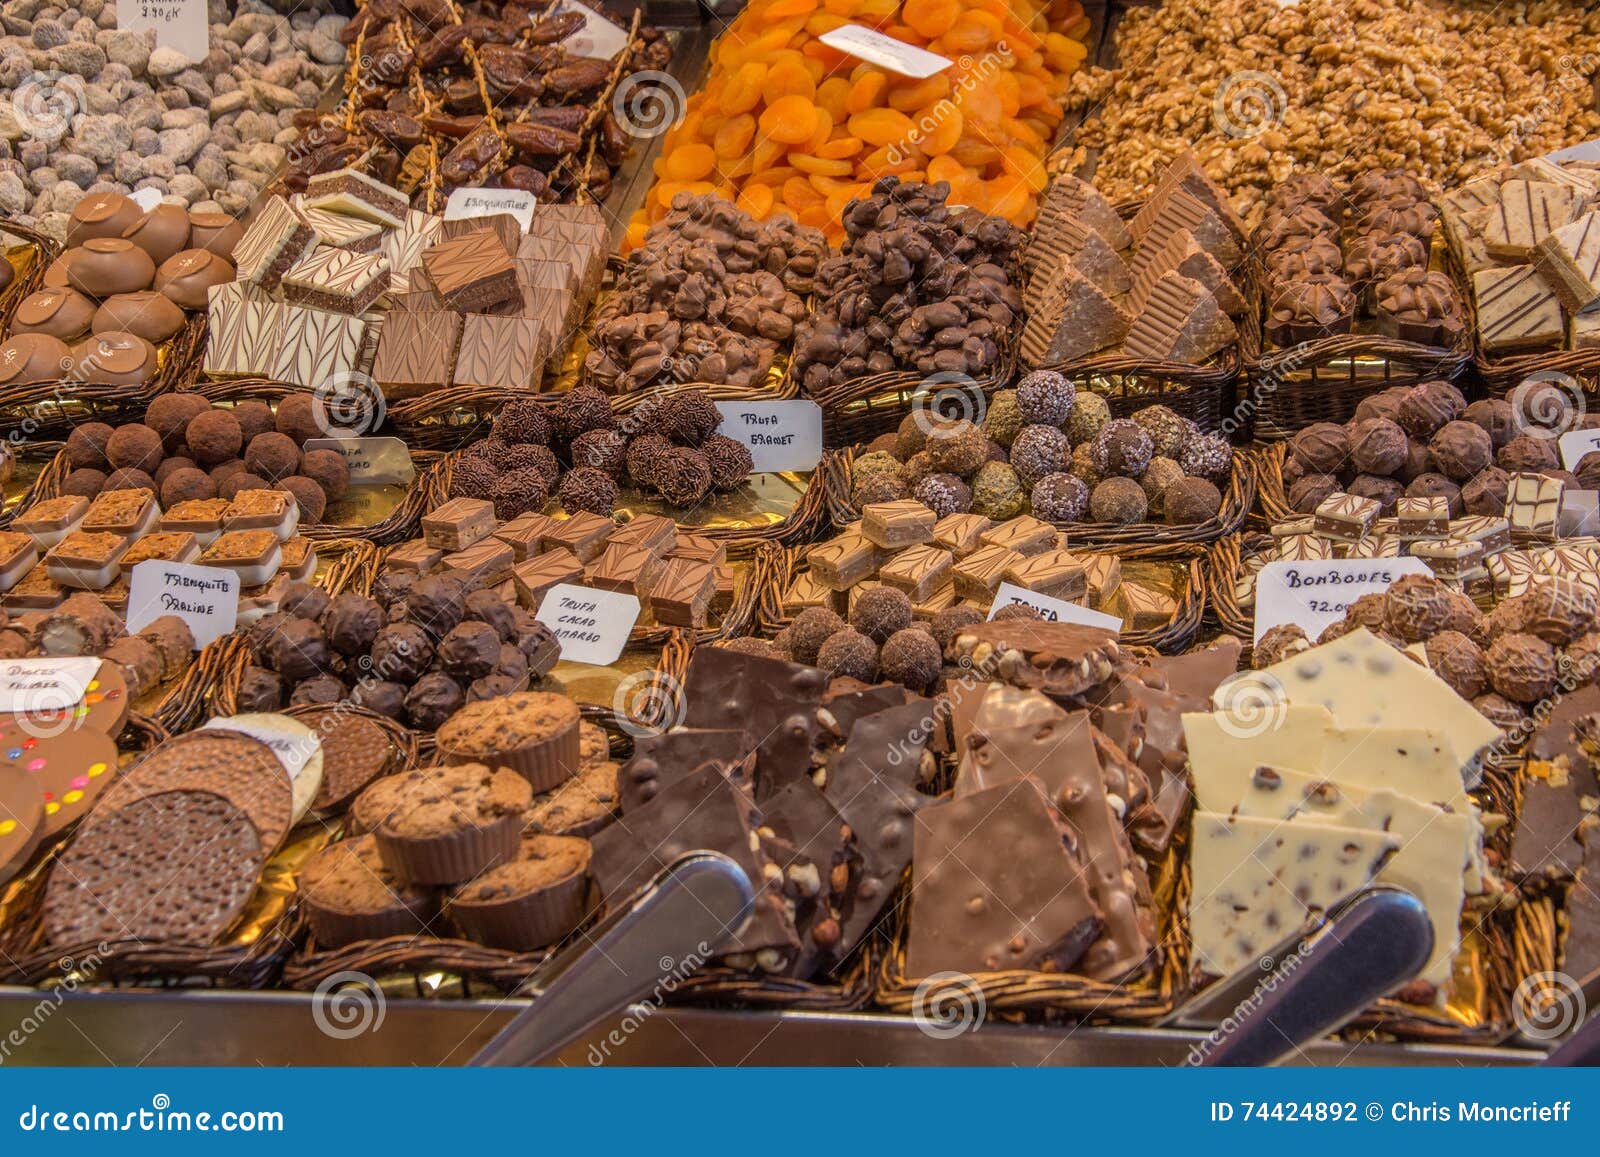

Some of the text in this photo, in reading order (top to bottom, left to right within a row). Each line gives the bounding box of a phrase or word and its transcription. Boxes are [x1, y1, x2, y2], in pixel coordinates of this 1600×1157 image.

[560, 597, 597, 612] TRUFA
[1010, 597, 1058, 622] TFA
[558, 615, 596, 627] CACAO
